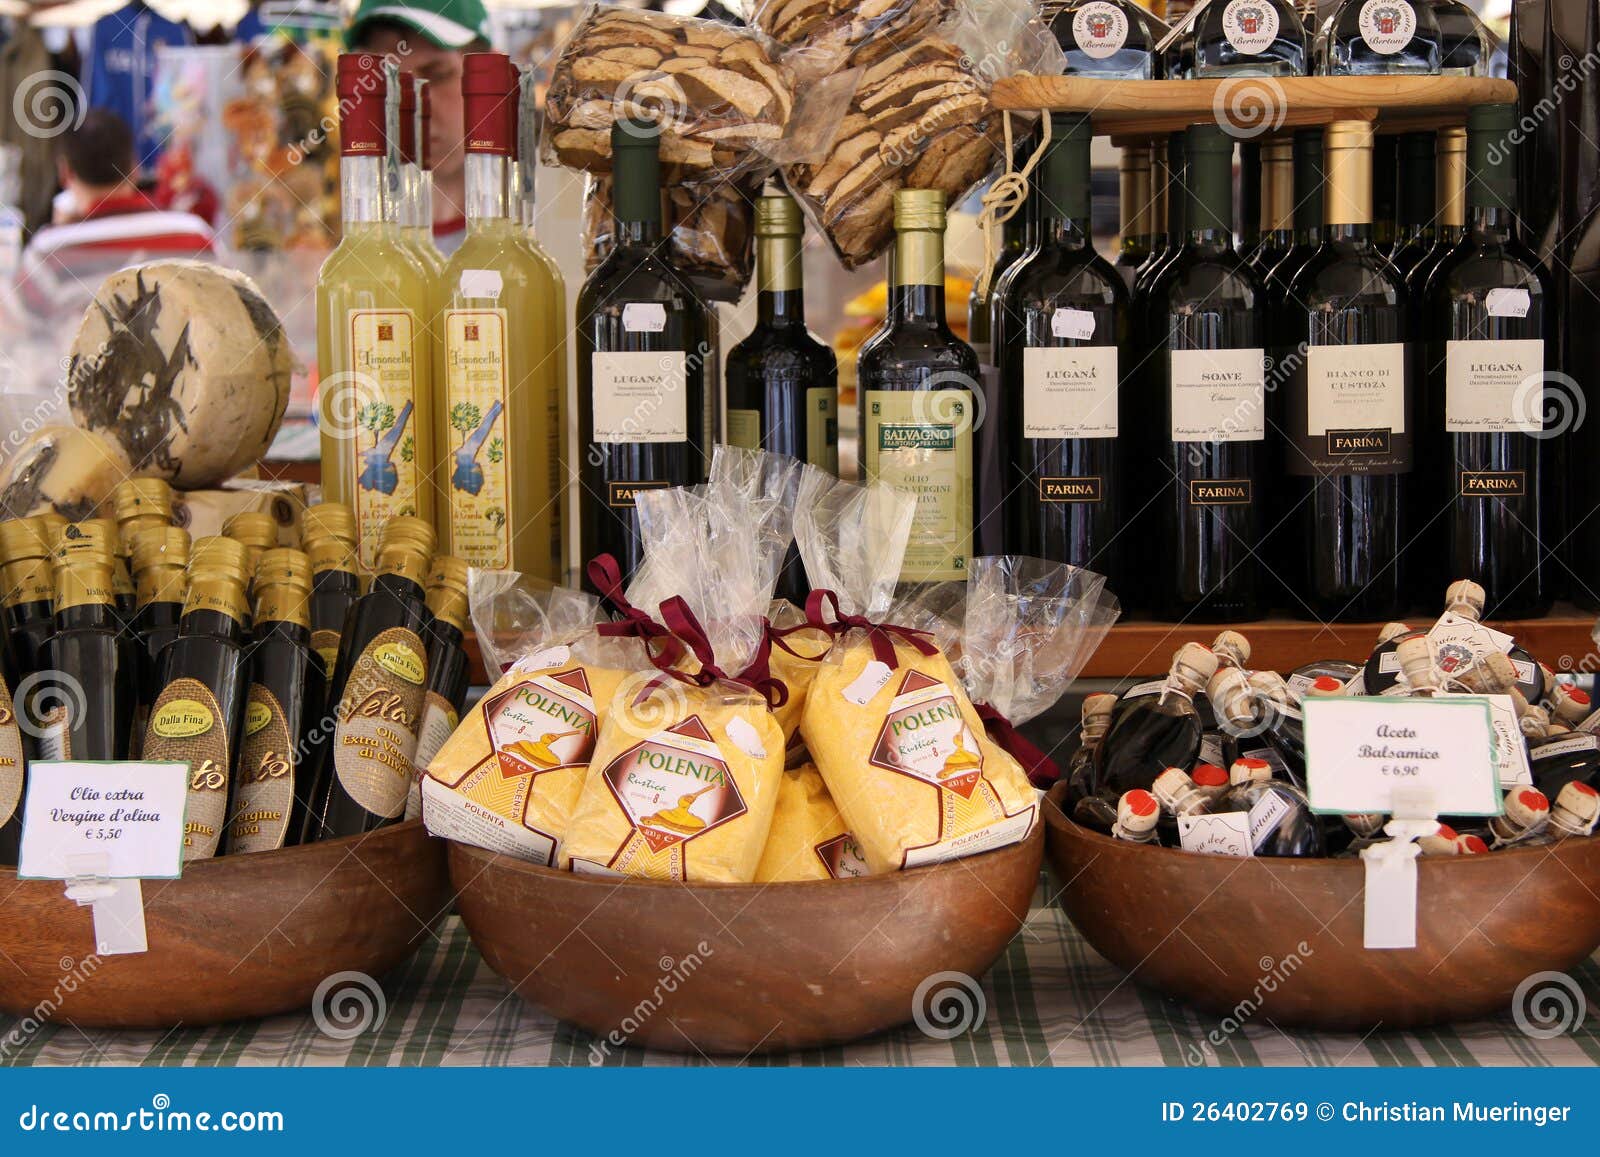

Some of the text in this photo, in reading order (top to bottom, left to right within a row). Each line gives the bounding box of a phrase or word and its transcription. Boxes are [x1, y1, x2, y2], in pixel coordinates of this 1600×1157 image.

[1233, 38, 1269, 46] Bertoni
[1368, 38, 1405, 46] Bertoni
[1327, 368, 1390, 379] BIANCO DI
[1470, 362, 1523, 372] LUGANA
[614, 375, 663, 384] LUGANA
[1201, 372, 1242, 381] SOAVE
[1331, 381, 1387, 390] CUSTOZA
[883, 428, 950, 440] SALVAGNO
[1336, 437, 1384, 448] FARINA
[1046, 484, 1094, 495] FARINA
[1198, 487, 1245, 497] FARINA
[1469, 479, 1518, 489] FARINA
[383, 652, 421, 677] Dalla Fina
[160, 713, 205, 726] Dalla Fina
[502, 706, 535, 726] Rustica
[514, 687, 592, 737] POLENTA
[891, 702, 963, 736] POLENT
[375, 725, 403, 746] Olio
[1376, 724, 1417, 738] Aceto
[343, 735, 380, 748] Extra
[898, 737, 938, 755] Rustica
[1358, 744, 1440, 760] Balsamico
[359, 746, 406, 777] di Oliva
[636, 749, 726, 787] POLENTA
[462, 761, 498, 794] POLENTA
[627, 772, 668, 792] Rustica
[70, 786, 145, 801] Olio extra
[511, 776, 527, 819] POLENTA
[652, 793, 660, 804] 8
[50, 808, 105, 826] Vergine
[464, 802, 506, 828] POLENTA
[946, 793, 955, 839] POLENTA
[1250, 804, 1279, 840] ertoni
[96, 828, 122, 841] 5,50
[950, 829, 991, 847] POLENTA
[615, 838, 644, 872] POLENTA
[670, 847, 679, 882] POLEN
